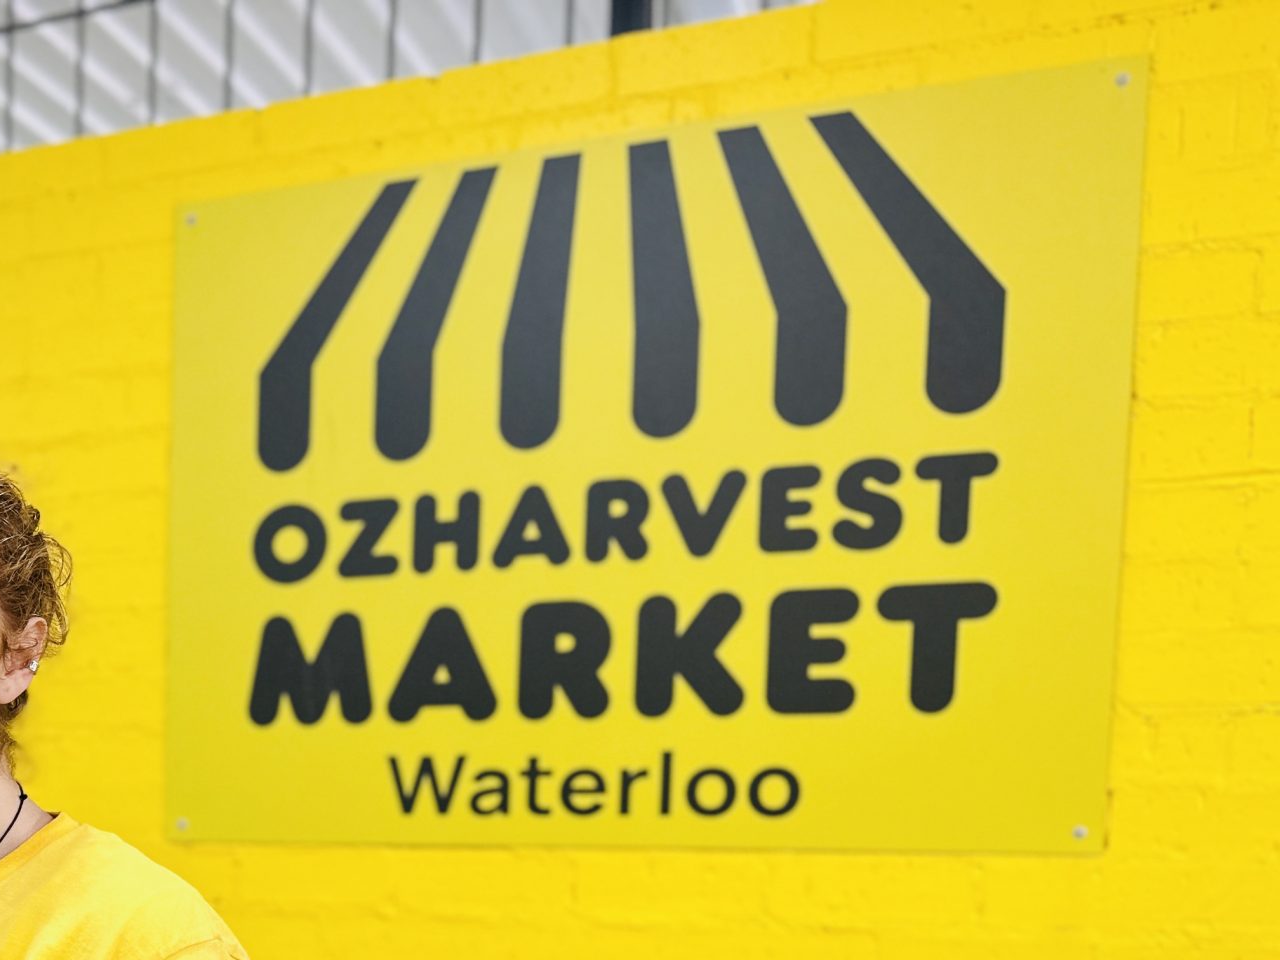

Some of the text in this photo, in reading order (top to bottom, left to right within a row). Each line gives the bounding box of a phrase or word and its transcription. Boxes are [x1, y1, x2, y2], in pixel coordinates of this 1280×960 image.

[252, 451, 999, 584] OZHARVEST
[247, 581, 999, 726] MARKET
[388, 750, 802, 817] Waterloo
